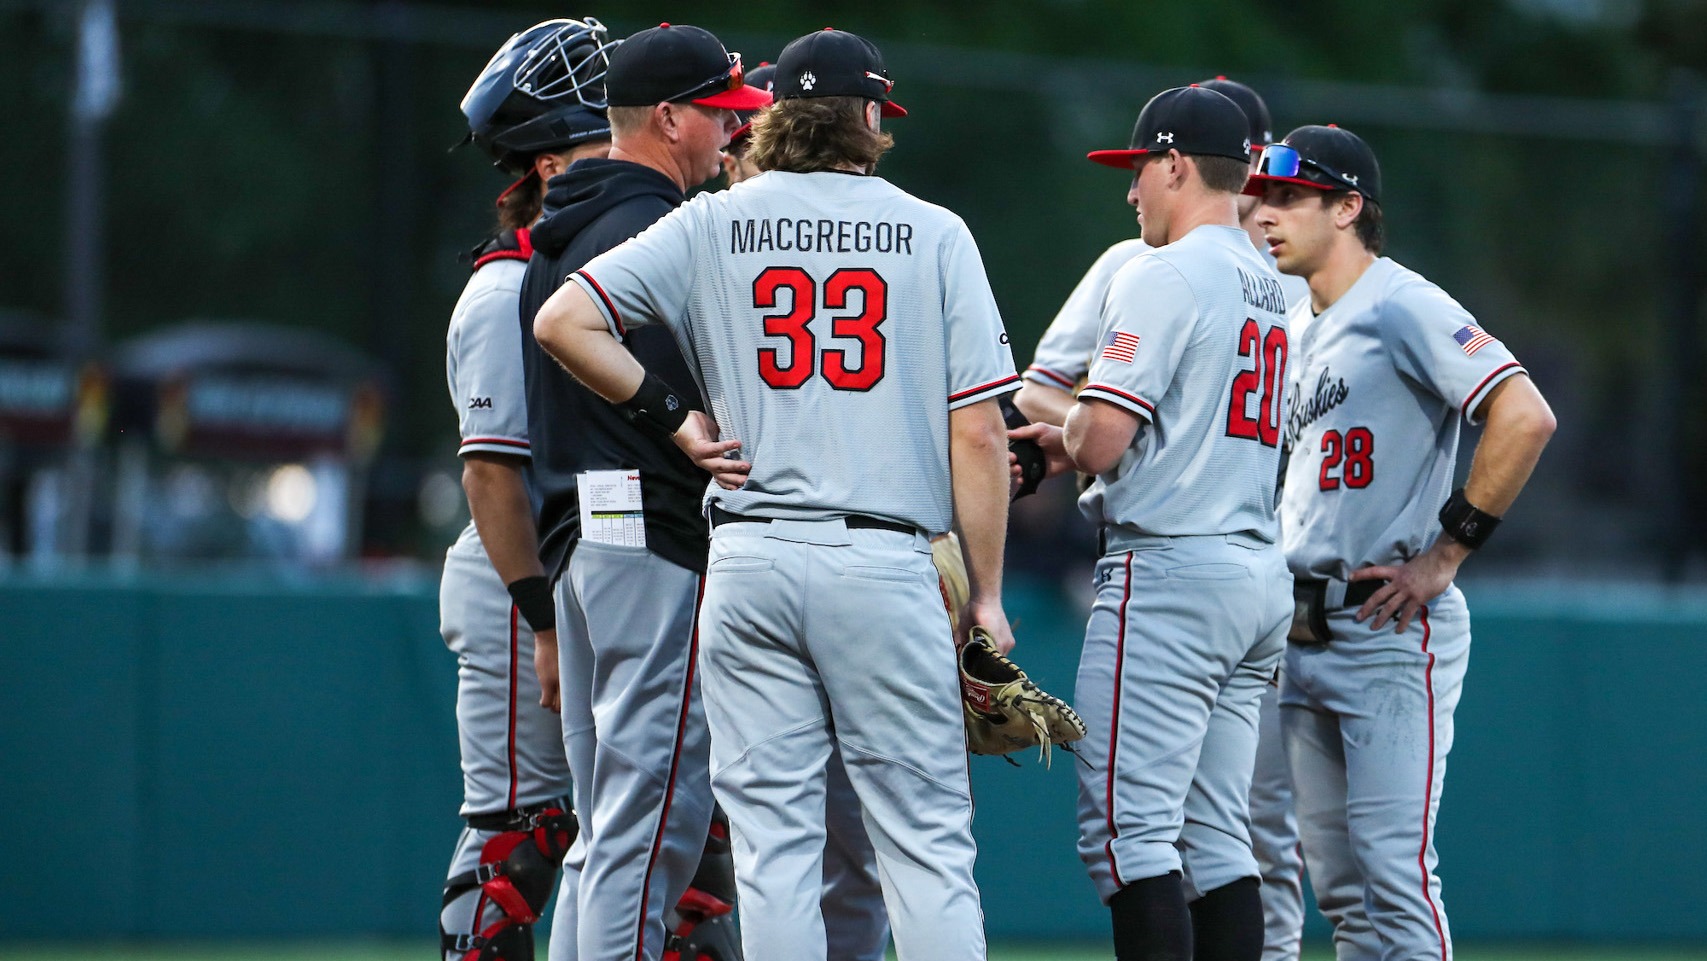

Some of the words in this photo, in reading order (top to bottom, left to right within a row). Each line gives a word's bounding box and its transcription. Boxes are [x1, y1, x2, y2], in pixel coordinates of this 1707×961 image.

[731, 218, 913, 255] MACGREGOR
[1237, 266, 1287, 315] ALLARD
[752, 266, 888, 392] 33
[1225, 317, 1288, 449] 20
[1319, 426, 1375, 492] 28
